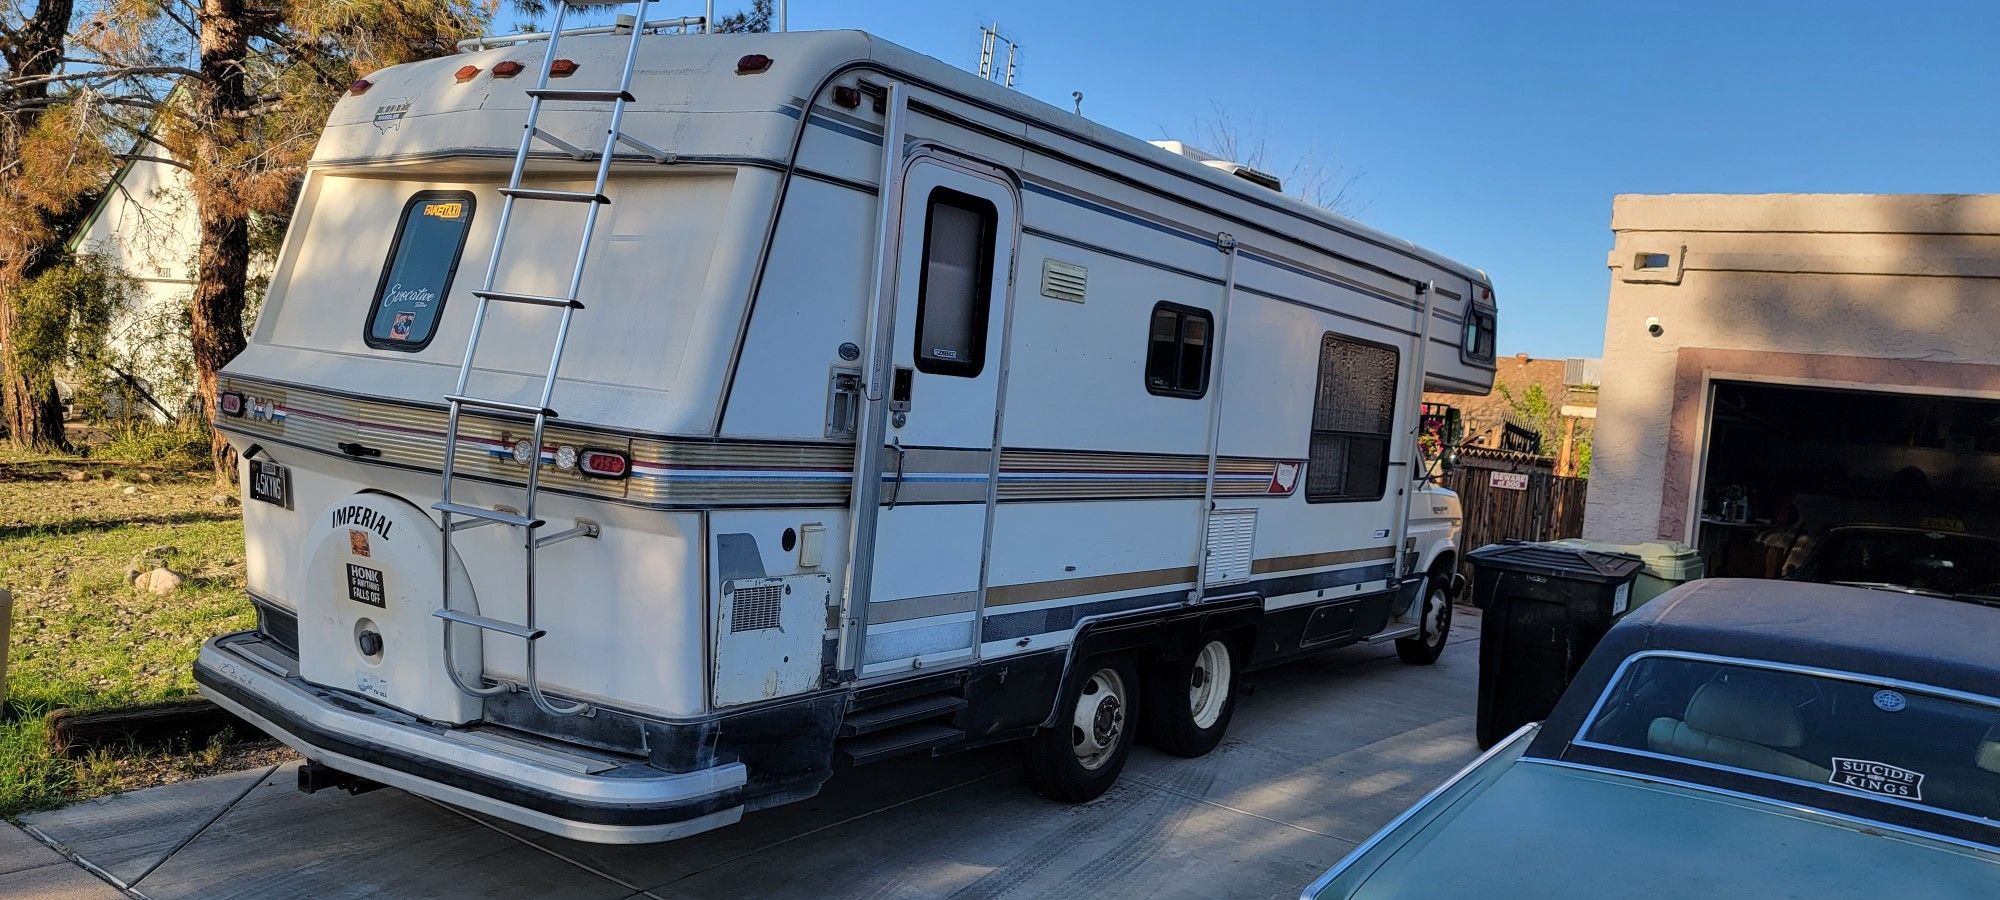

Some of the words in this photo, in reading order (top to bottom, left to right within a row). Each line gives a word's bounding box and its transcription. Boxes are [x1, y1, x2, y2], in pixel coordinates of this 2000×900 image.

[1493, 472, 1526, 482] BEWARE
[332, 505, 393, 541] IMPERIAL
[351, 565, 379, 583] HONK
[353, 586, 370, 601] FALLS
[370, 591, 381, 604] OFF
[1842, 761, 1914, 783] SUICIDE
[1845, 774, 1909, 796] KINGS
